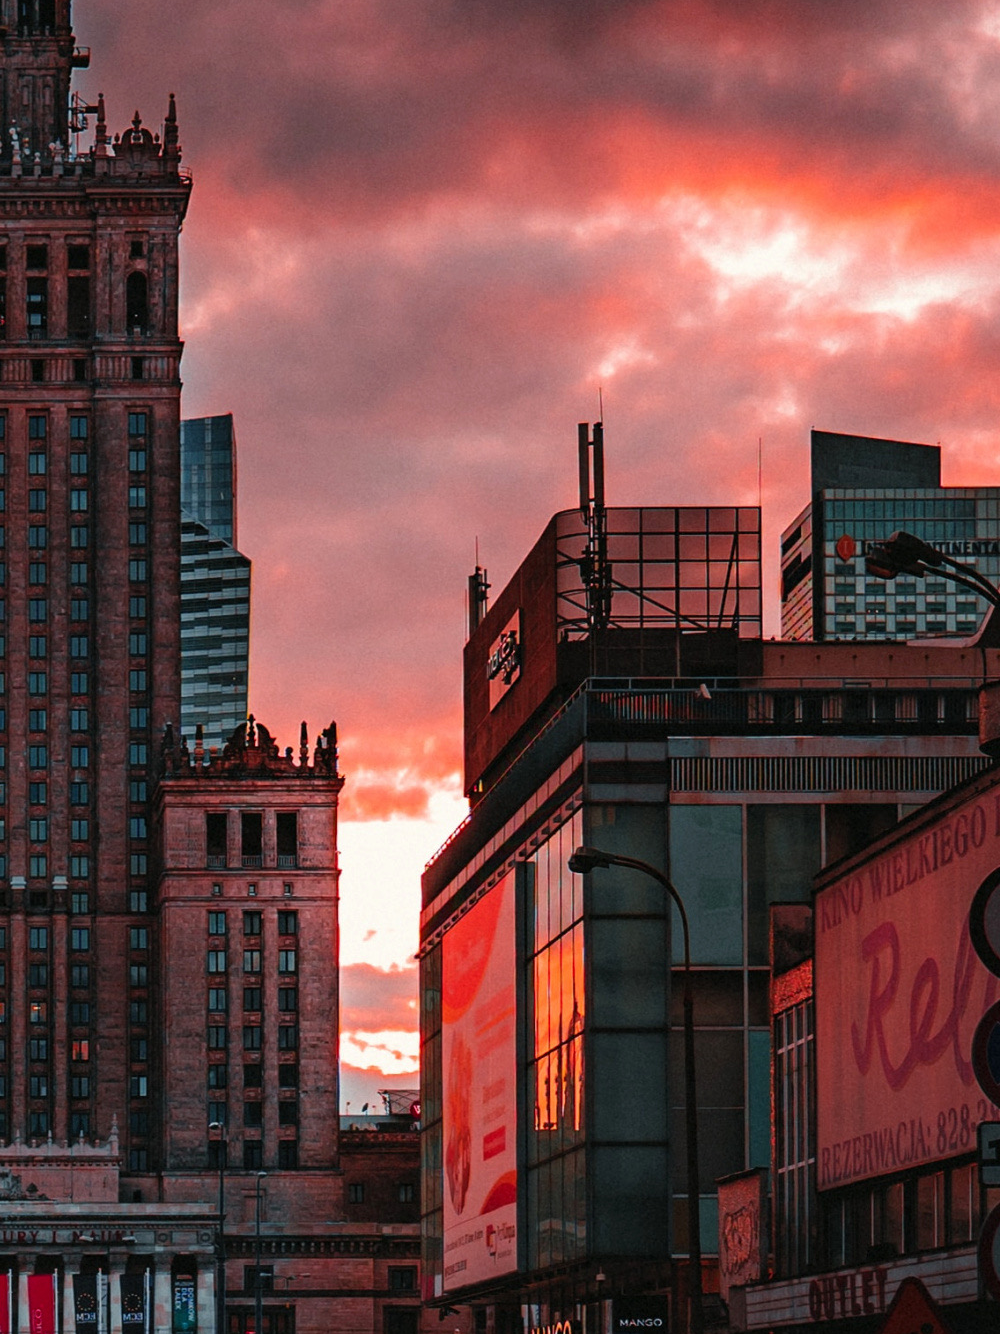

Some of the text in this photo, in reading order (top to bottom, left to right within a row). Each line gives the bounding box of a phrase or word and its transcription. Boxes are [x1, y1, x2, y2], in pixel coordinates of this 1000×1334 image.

[820, 874, 864, 933] KINO
[868, 805, 987, 903] WIELKIEGO
[52, 1230, 58, 1244] I
[808, 1267, 888, 1320] OUTLET
[619, 1318, 663, 1327] MANGO
